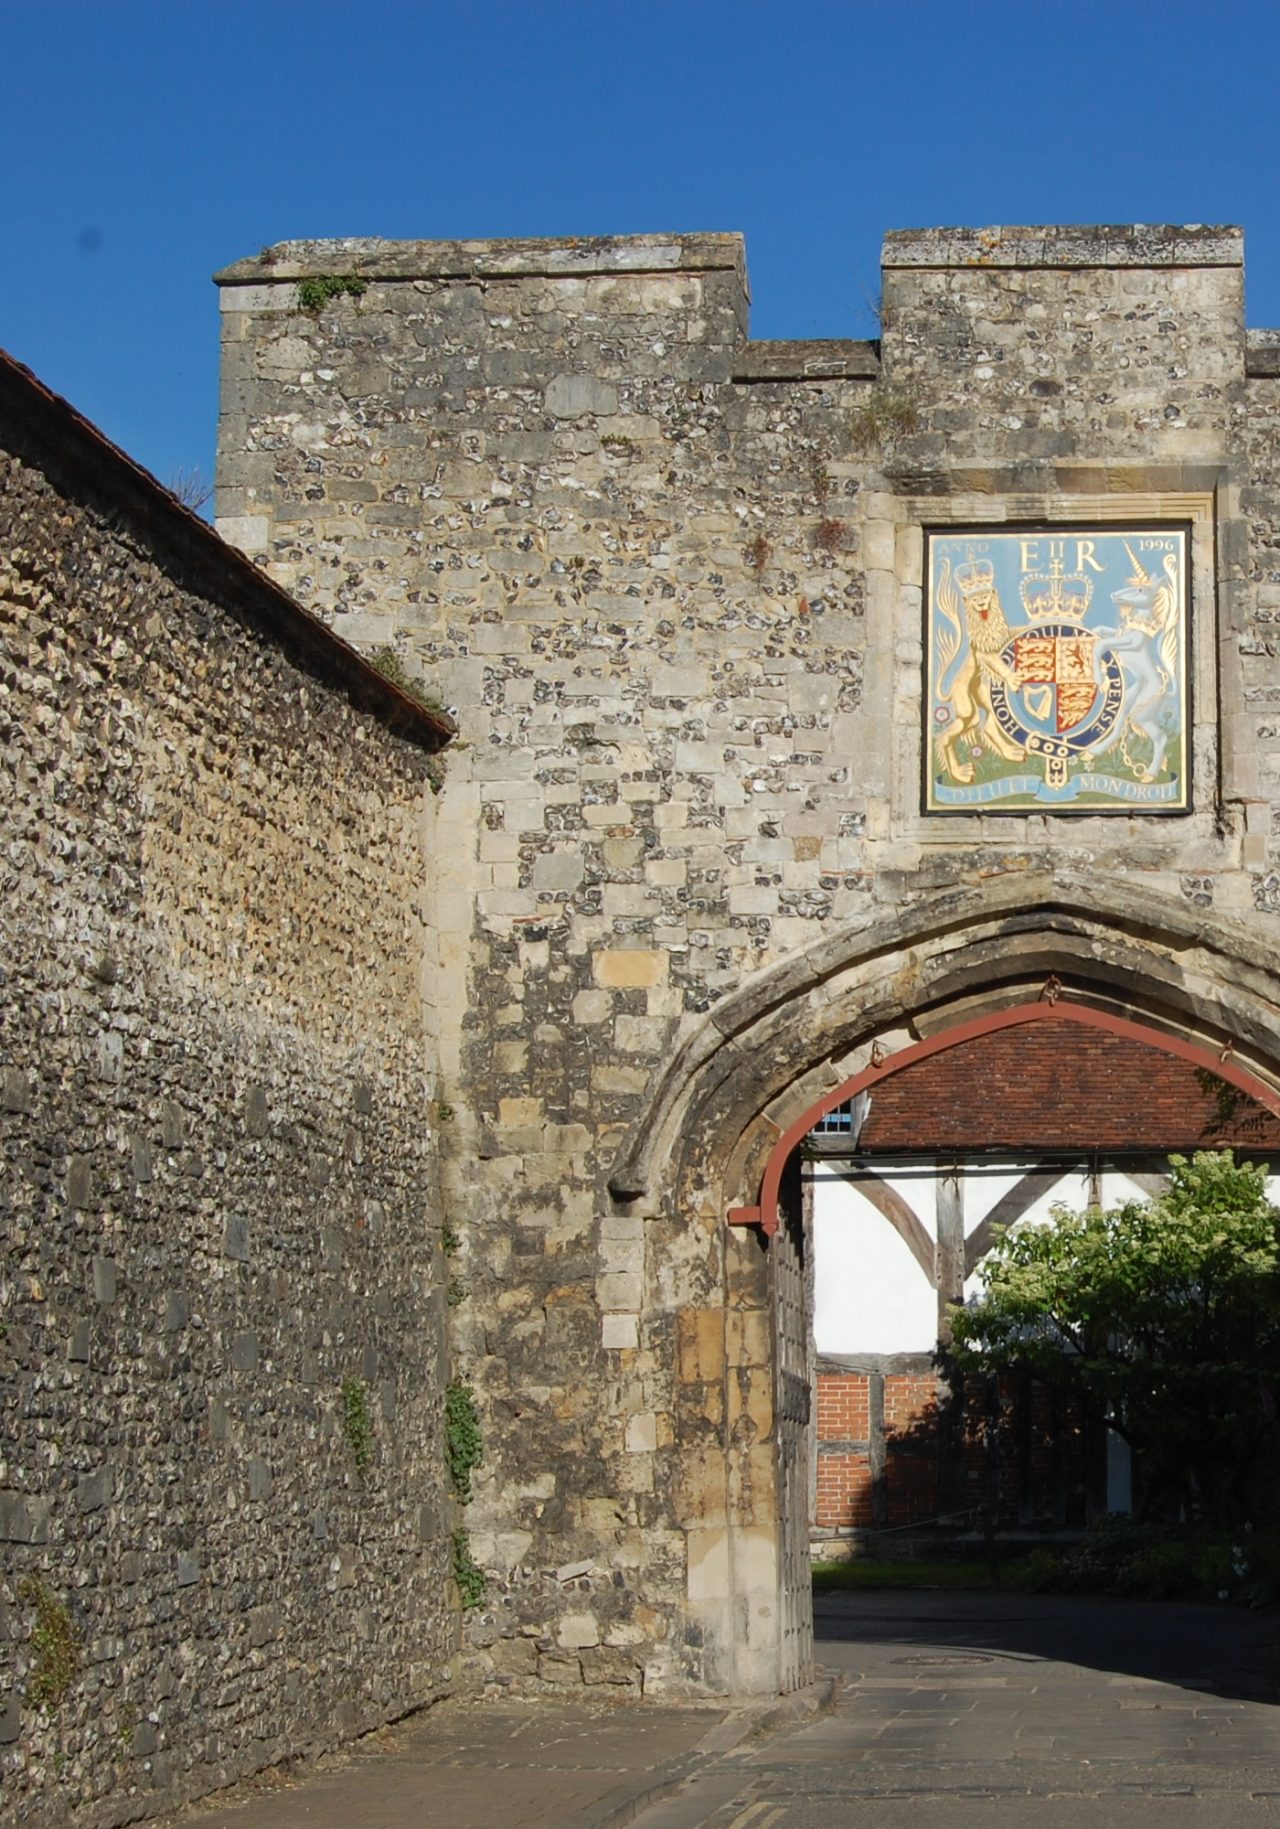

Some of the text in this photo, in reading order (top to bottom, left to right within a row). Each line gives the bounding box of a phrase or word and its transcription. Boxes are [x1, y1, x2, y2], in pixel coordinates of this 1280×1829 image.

[938, 542, 989, 553] ANNO
[1020, 541, 1042, 573] E
[1076, 540, 1107, 572] R
[1139, 539, 1174, 551] 1996
[1091, 678, 1121, 733] PENSE
[1080, 775, 1121, 793] MON
[1124, 783, 1175, 800] DROIT
